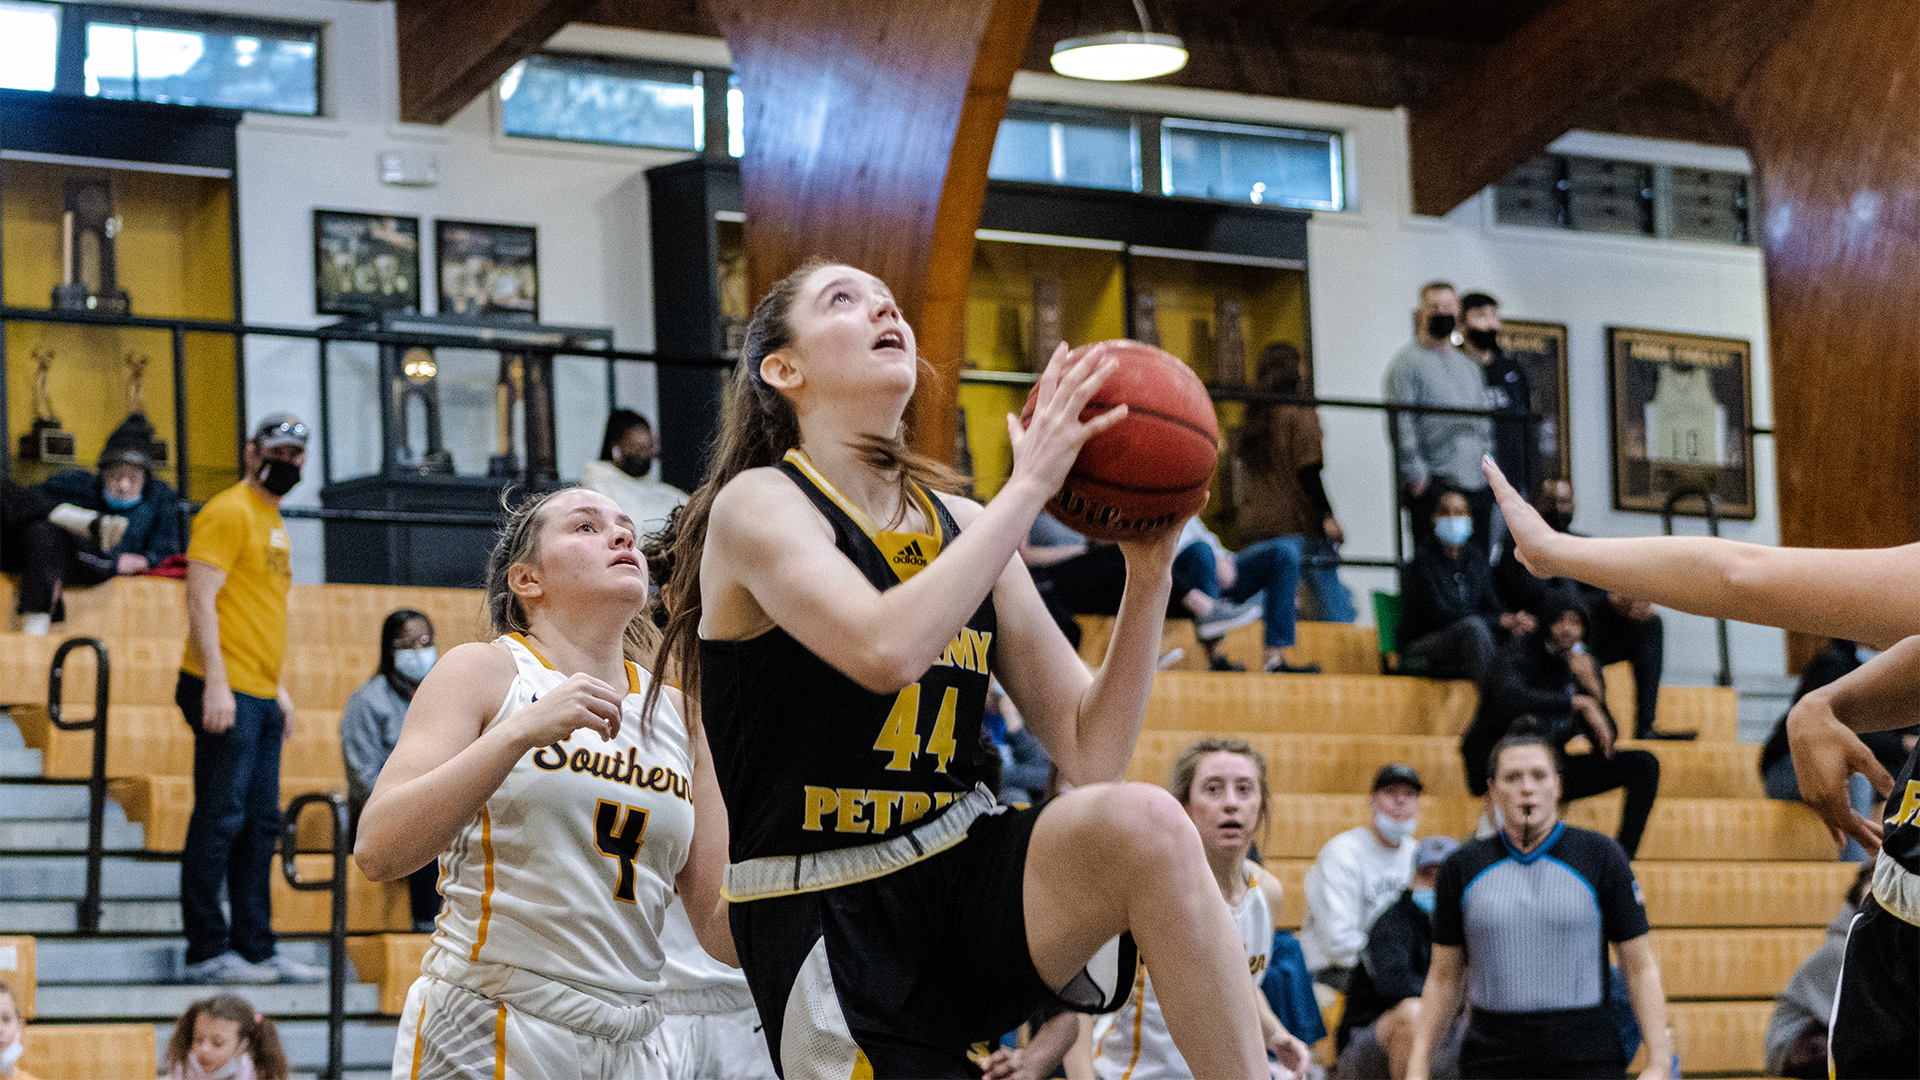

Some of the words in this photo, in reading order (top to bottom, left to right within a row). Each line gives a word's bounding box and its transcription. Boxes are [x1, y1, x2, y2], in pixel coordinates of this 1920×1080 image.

[893, 554, 928, 567] adidas
[873, 682, 959, 774] 44
[532, 733, 694, 806] Southern
[802, 784, 969, 835] PETR
[593, 797, 650, 905] 4
